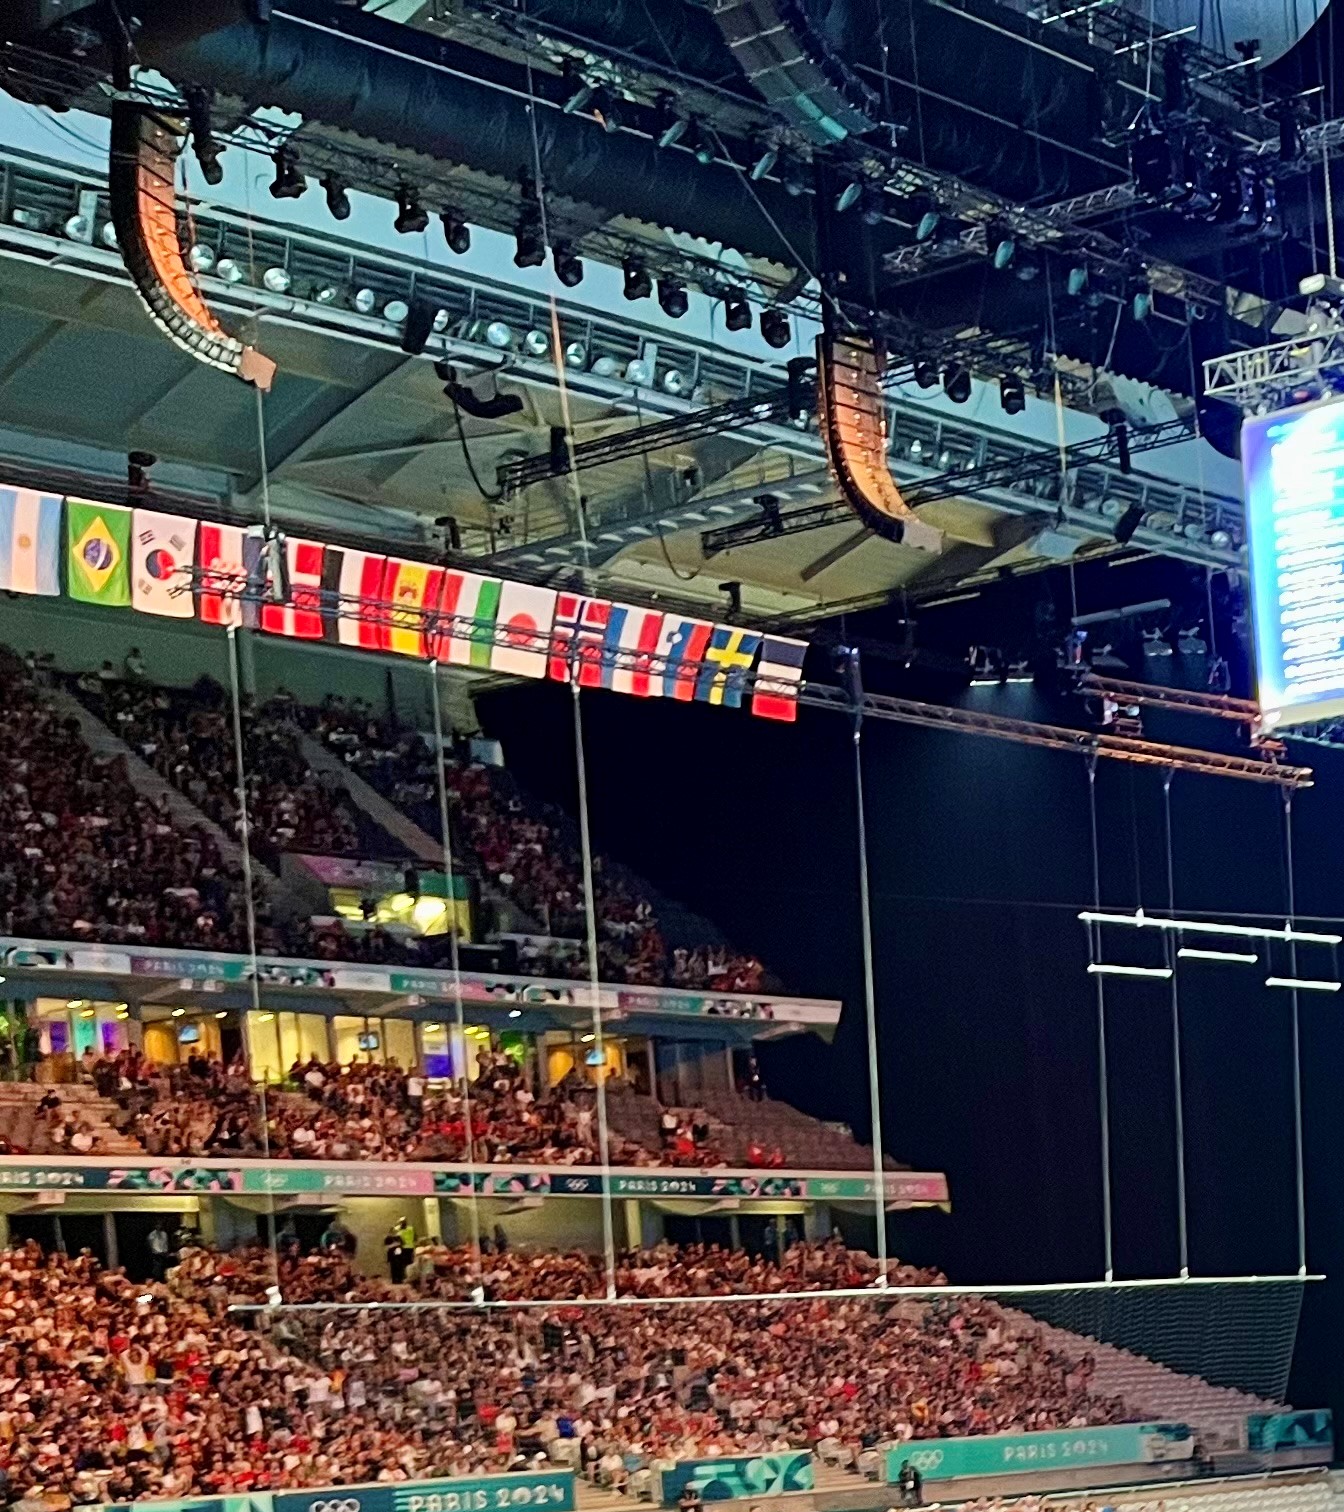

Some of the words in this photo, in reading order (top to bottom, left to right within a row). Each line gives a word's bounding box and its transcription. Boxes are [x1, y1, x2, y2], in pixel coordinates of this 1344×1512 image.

[34, 1171, 84, 1186] 2024
[619, 1180, 658, 1192] PARIS
[660, 1180, 696, 1193] 2024
[1003, 1442, 1056, 1462] PARIS
[1061, 1439, 1108, 1457] 2024
[495, 1484, 564, 1508] 2024
